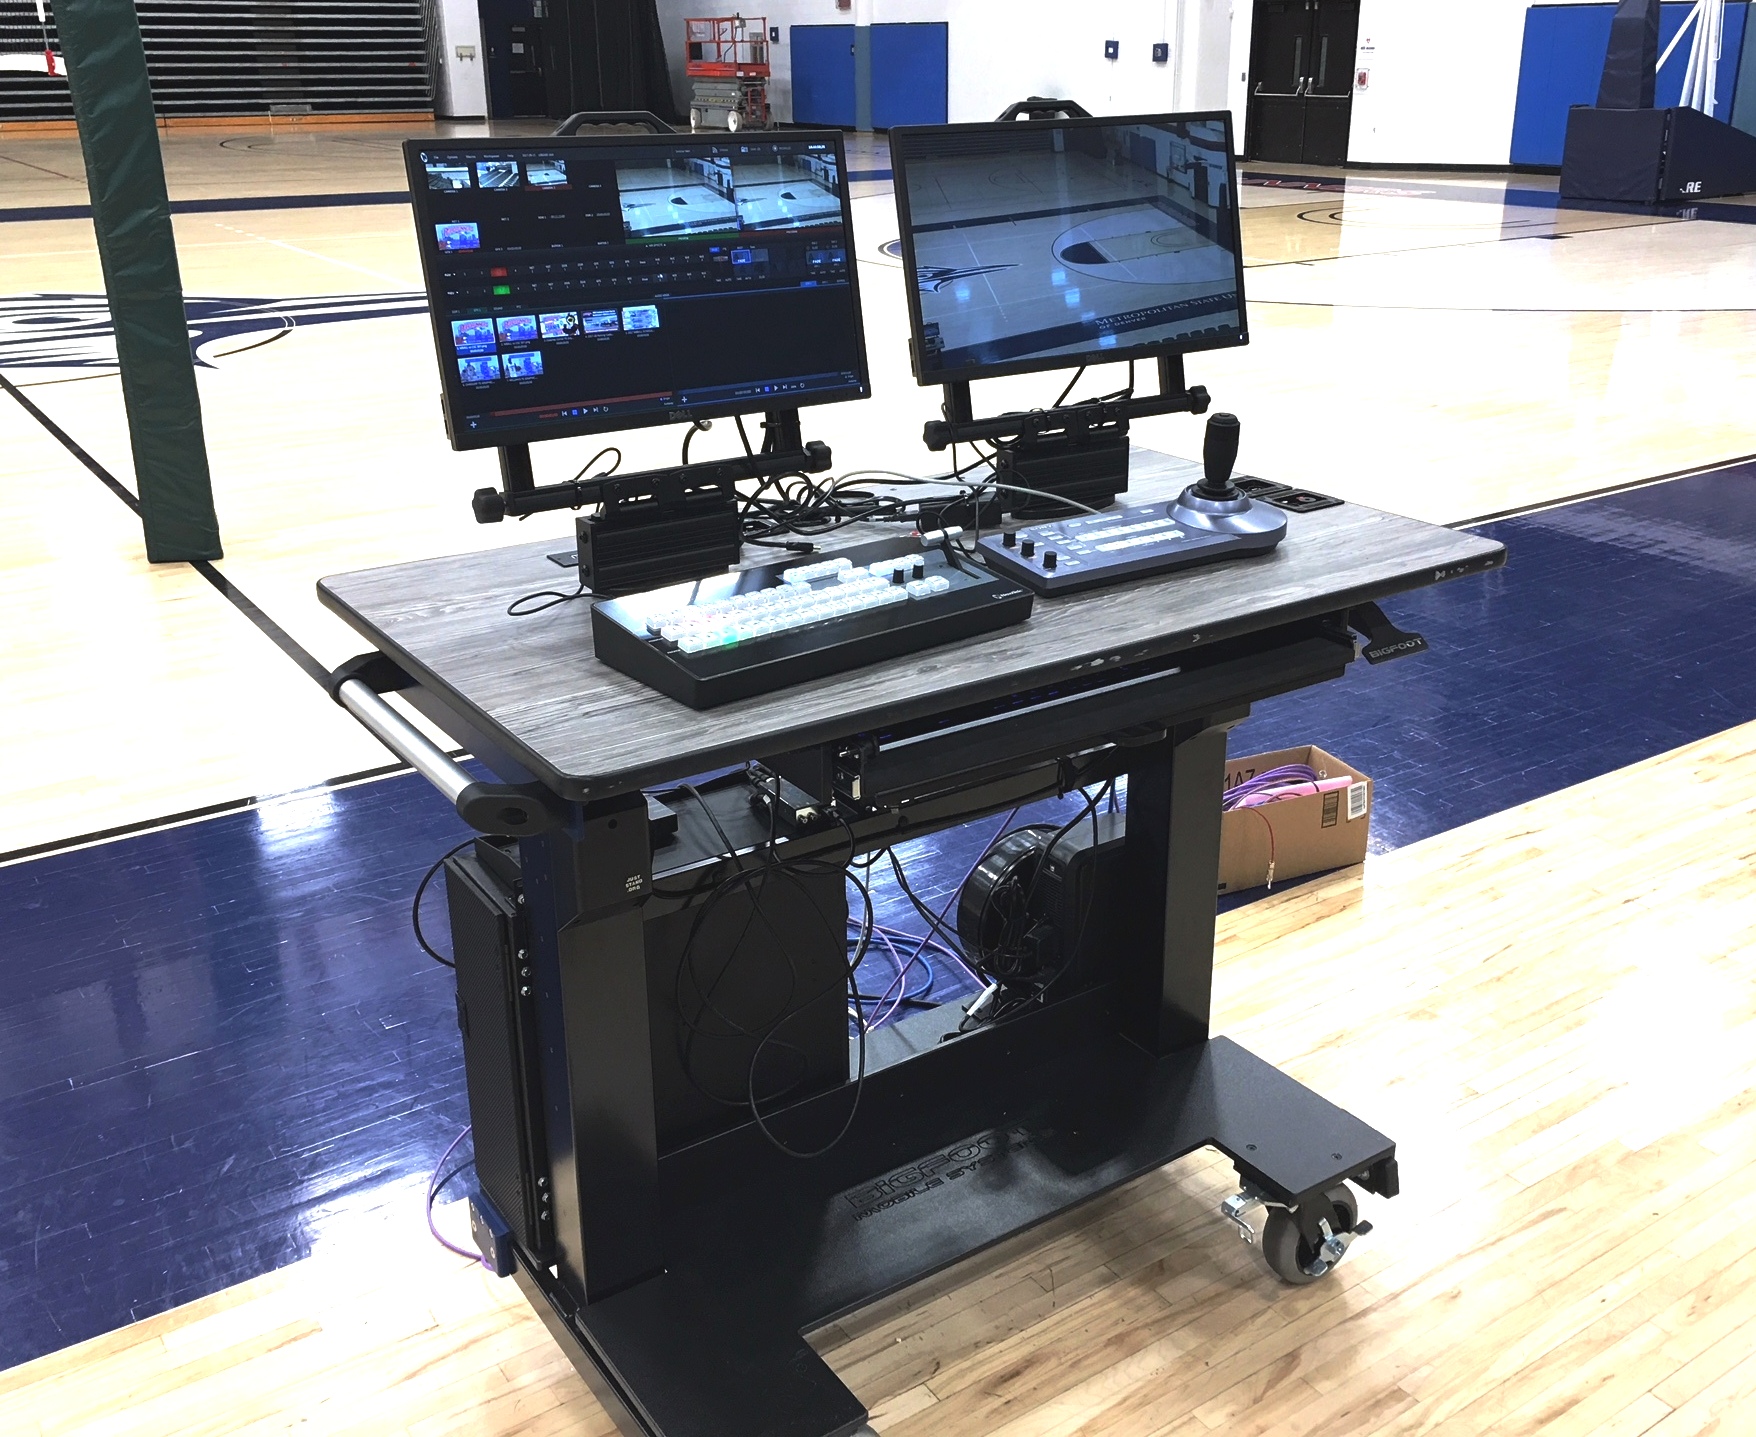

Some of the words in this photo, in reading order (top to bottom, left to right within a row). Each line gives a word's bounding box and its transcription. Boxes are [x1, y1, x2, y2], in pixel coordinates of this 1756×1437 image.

[1680, 181, 1702, 193] RE
[1095, 303, 1189, 326] METROPOLITAN
[1114, 316, 1147, 327] DENVER
[668, 409, 693, 420] DELL
[1369, 637, 1422, 658] BIGFOOT
[625, 878, 643, 888] STAND
[626, 874, 641, 882] JUST
[853, 1177, 945, 1221] MOBILE
